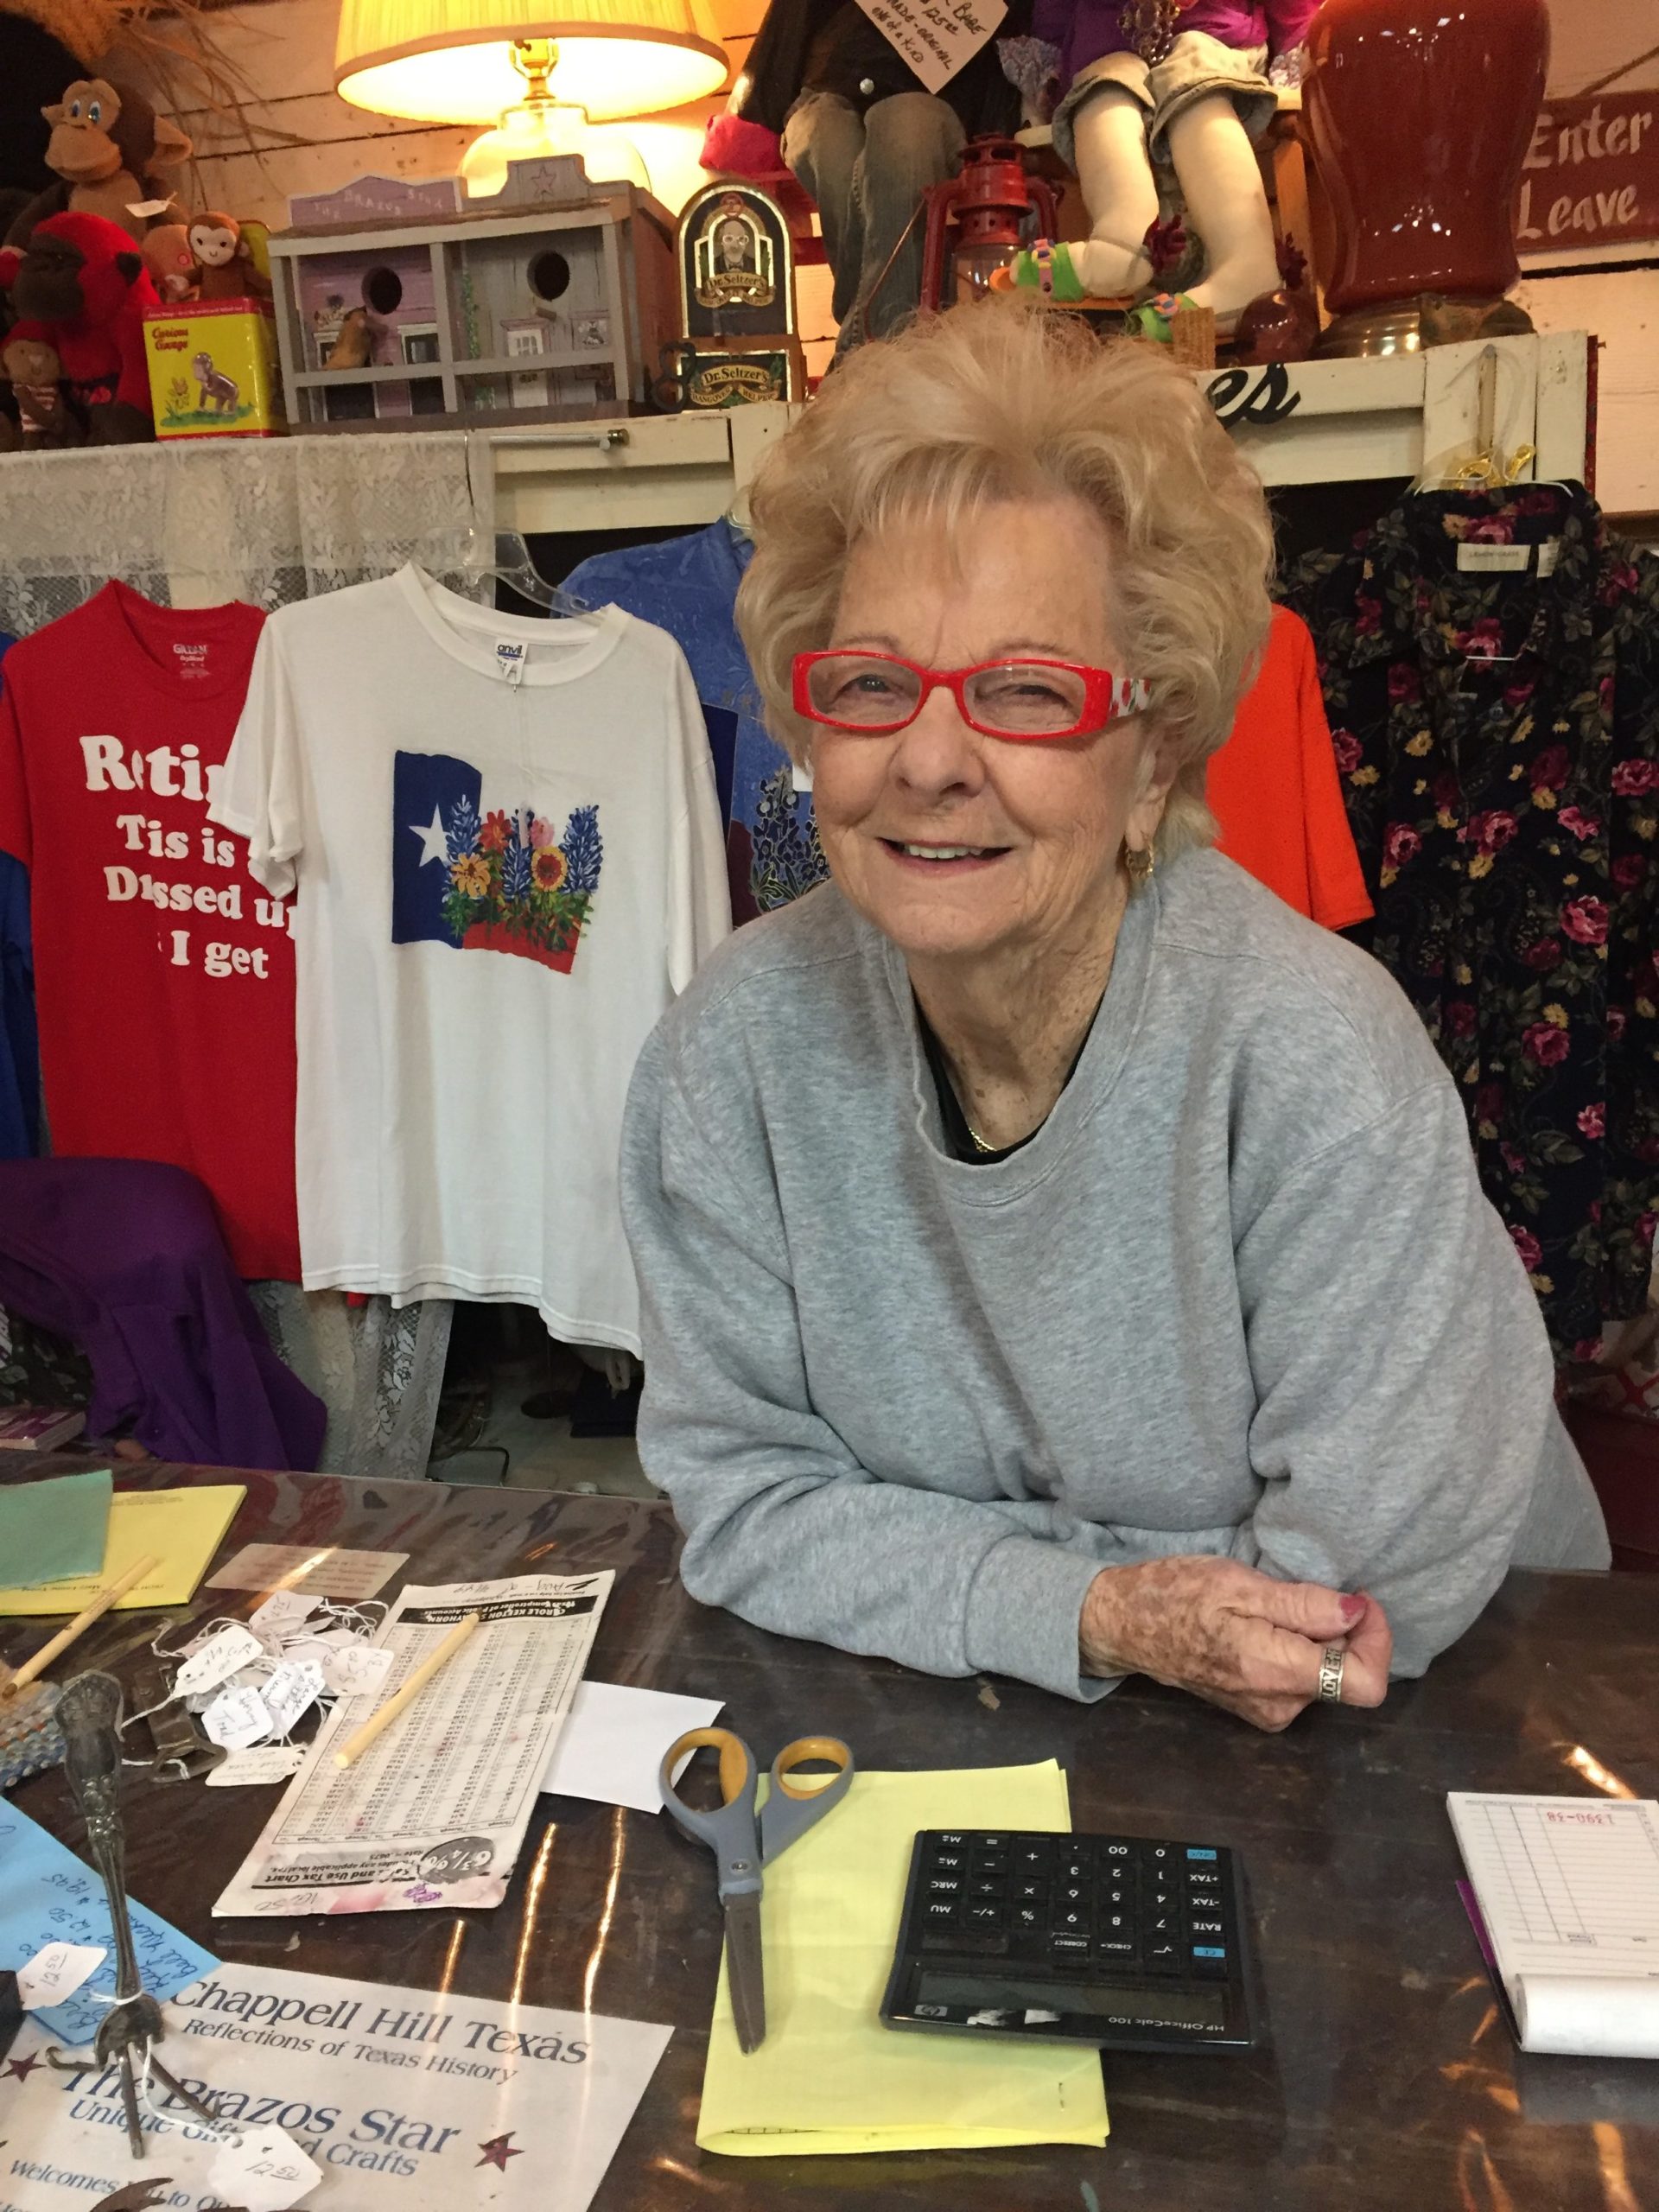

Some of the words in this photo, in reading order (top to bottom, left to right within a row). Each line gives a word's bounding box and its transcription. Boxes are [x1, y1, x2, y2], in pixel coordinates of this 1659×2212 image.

[1522, 103, 1654, 171] Enter
[1516, 180, 1639, 240] Leave
[498, 644, 523, 654] anvil
[200, 827, 235, 868] is
[170, 930, 190, 966] I
[204, 942, 269, 979] get
[1070, 1866, 1079, 1875] 3
[1112, 1868, 1122, 1878] 2
[264, 1874, 299, 1883] Chart
[303, 1873, 324, 1882] Tax
[327, 1872, 349, 1880] Use
[930, 1880, 957, 1890] MRC
[1111, 1892, 1121, 1901] 5
[1156, 1894, 1166, 1904] 4
[930, 1904, 951, 1913] MU
[1112, 1916, 1121, 1926] 8
[1156, 1919, 1166, 1928] 7
[1192, 1922, 1222, 1932] RATE
[170, 1981, 362, 2030] Chappell
[366, 2007, 454, 2044] Hill
[463, 2020, 591, 2064] Texas
[181, 2018, 315, 2052] Reflections
[320, 2040, 350, 2056] of
[353, 2044, 422, 2068] Texas
[425, 2055, 518, 2085] History
[158, 2077, 342, 2134] Brazos
[348, 2109, 461, 2154] Star
[326, 2142, 420, 2177] Crafts
[10, 2158, 119, 2194] Welcomes
[166, 2190, 191, 2207] to
